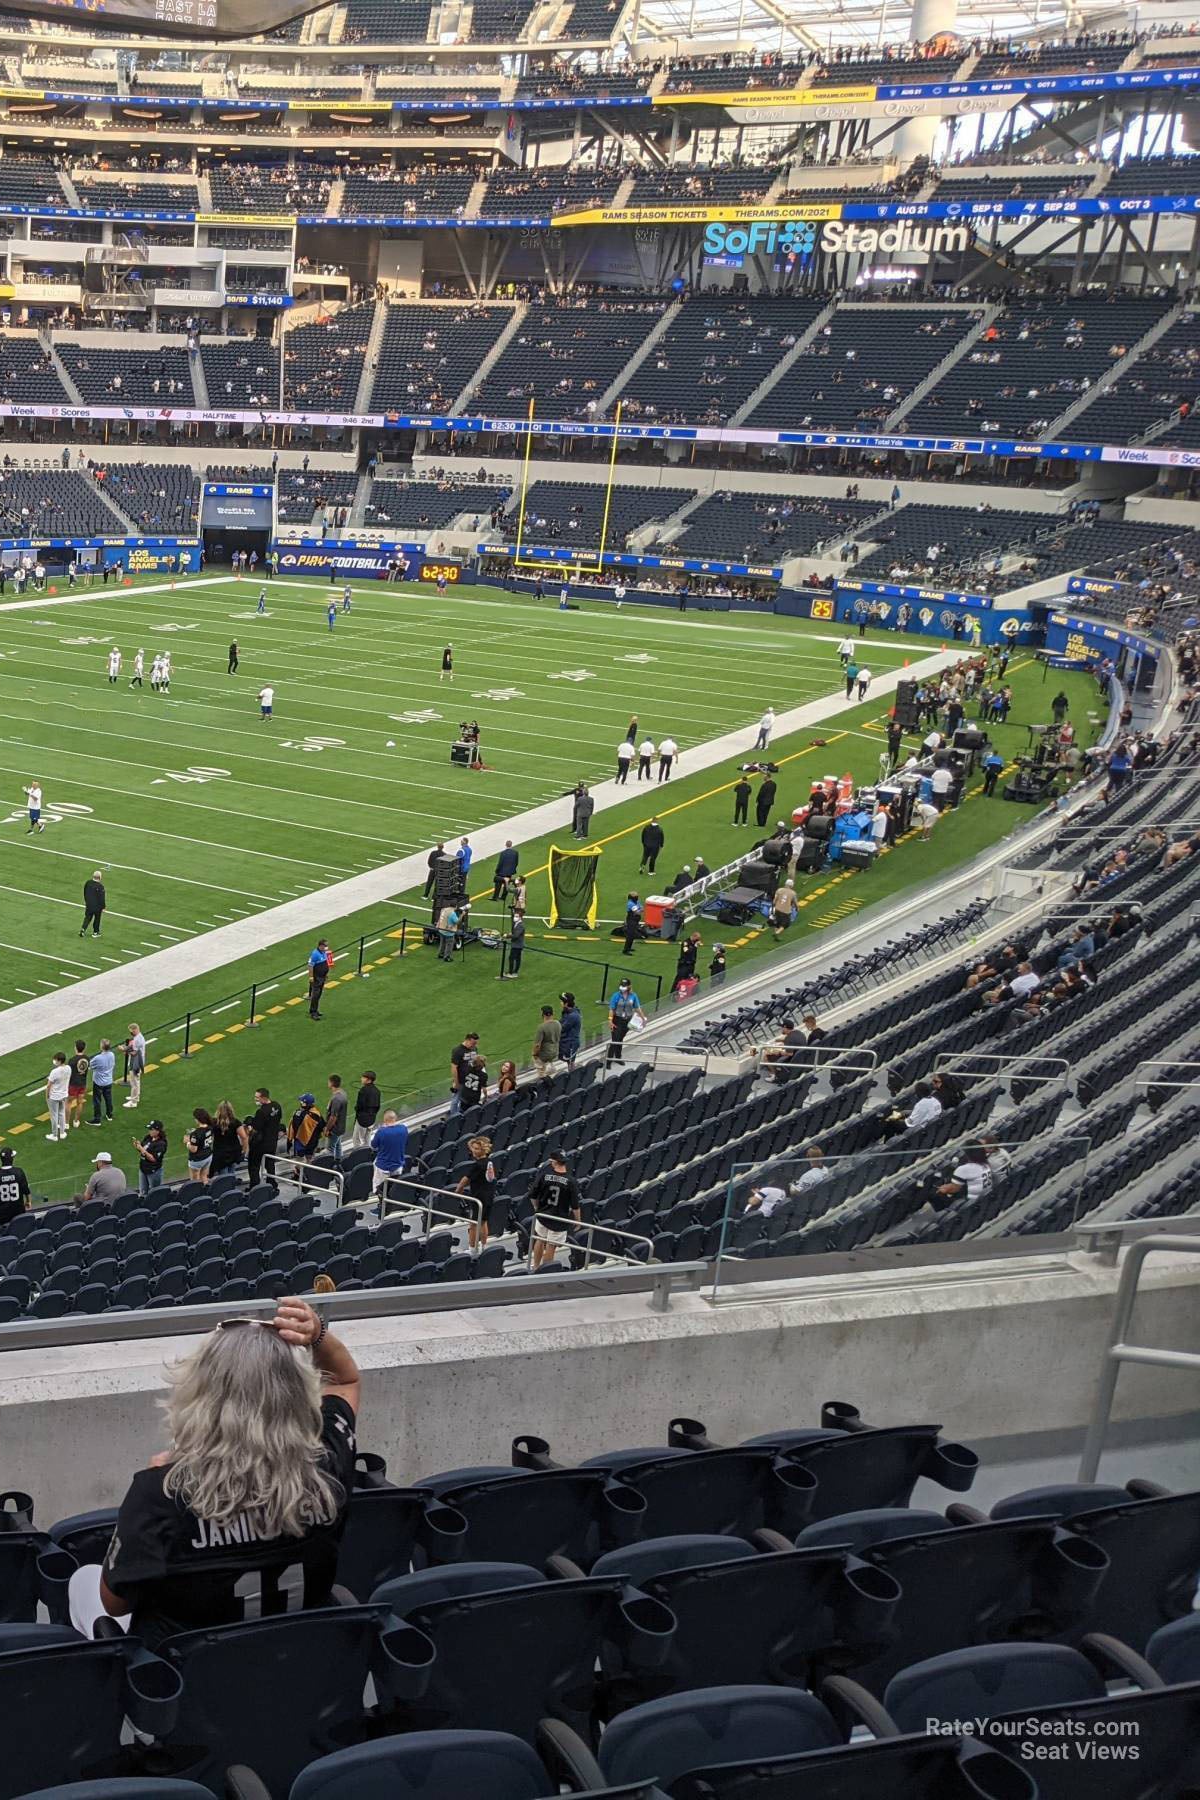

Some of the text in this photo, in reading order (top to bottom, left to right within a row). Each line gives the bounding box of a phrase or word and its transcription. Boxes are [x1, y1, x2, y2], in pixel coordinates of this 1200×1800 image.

[630, 211, 666, 219] SEASON
[670, 210, 707, 219] TICKETS
[735, 208, 830, 218] THERAMS.COM/2021
[896, 206, 915, 214] AUG
[917, 205, 928, 214] 21
[972, 204, 991, 213] SEP
[992, 204, 1003, 212] 12
[1044, 202, 1062, 212] SEP
[1120, 200, 1142, 210] OCT
[1142, 200, 1150, 209] 3
[704, 220, 968, 254] SoFi Stadium
[253, 297, 282, 305] $11,140
[61, 408, 90, 416] Scores
[491, 422, 516, 430] 62:30
[1119, 450, 1148, 460] Week
[331, 556, 409, 571] FOOTBALL.C
[422, 567, 456, 580] 62:30
[812, 604, 830, 617] 25
[0, 1183, 19, 1202] 89
[548, 1186, 560, 1206] 3
[233, 1562, 304, 1622] 11
